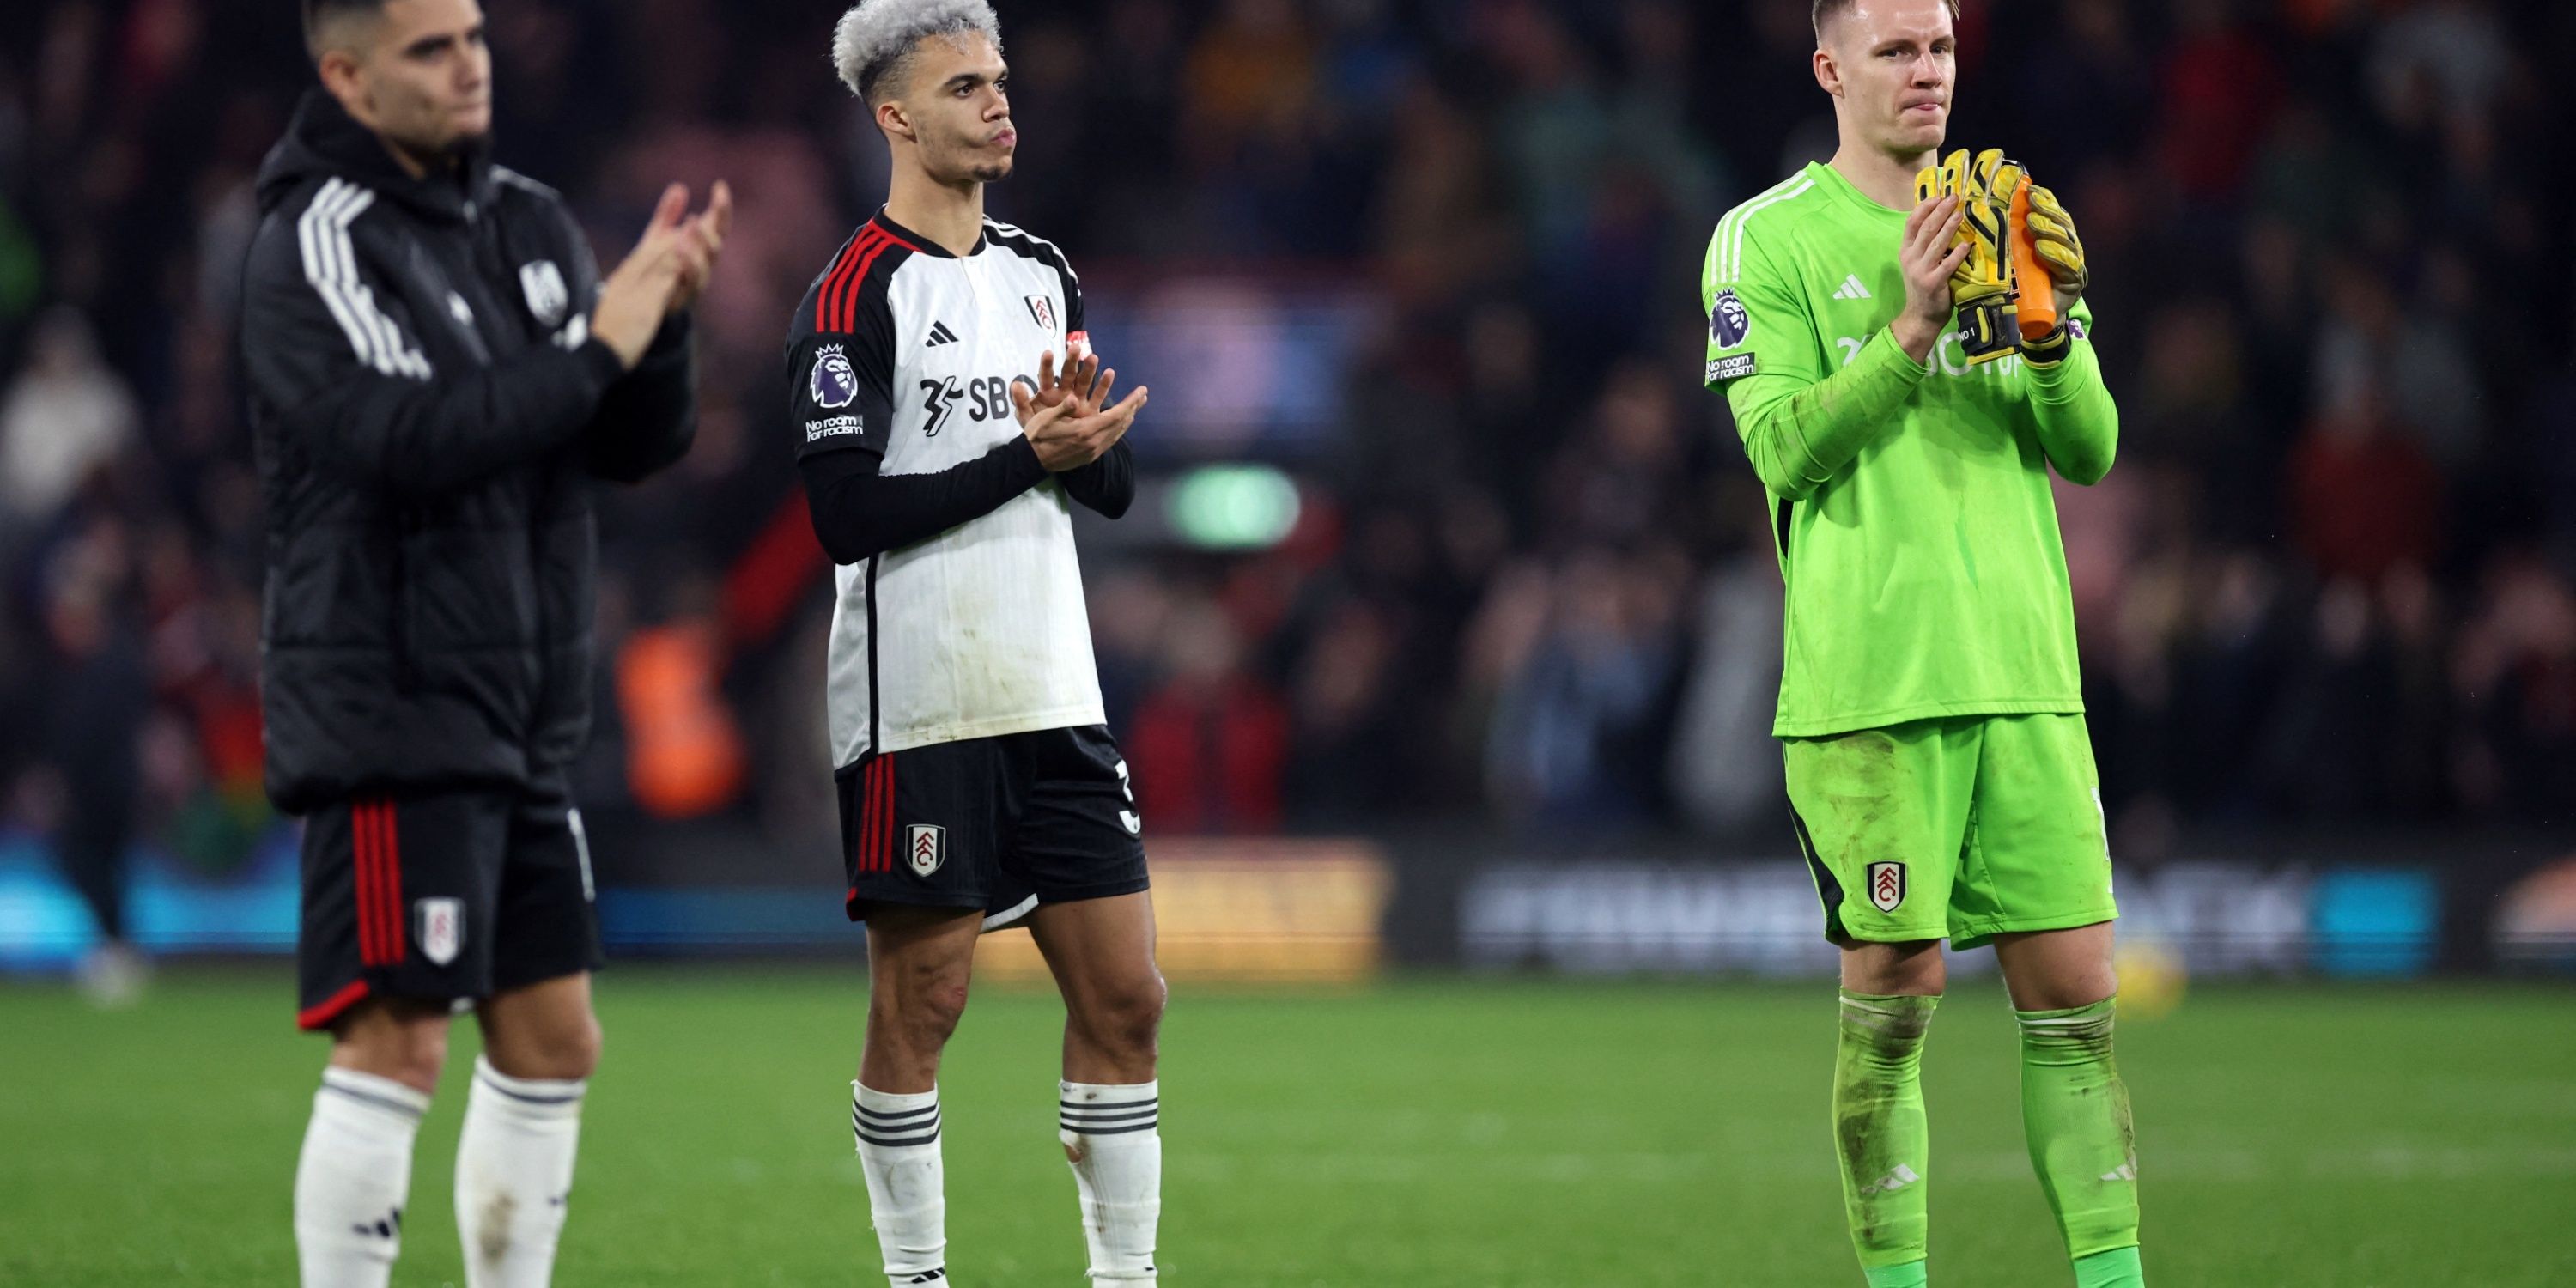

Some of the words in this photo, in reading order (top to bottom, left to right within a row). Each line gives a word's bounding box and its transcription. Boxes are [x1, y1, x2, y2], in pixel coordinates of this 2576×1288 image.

[1707, 361, 1720, 372] No
[1721, 355, 1750, 369] room
[1720, 364, 1753, 379] racism
[805, 420, 822, 431] No
[823, 416, 856, 428] room
[806, 429, 823, 442] for
[823, 426, 863, 437] racism
[915, 830, 935, 866] FFC
[1877, 866, 1897, 902] FFC
